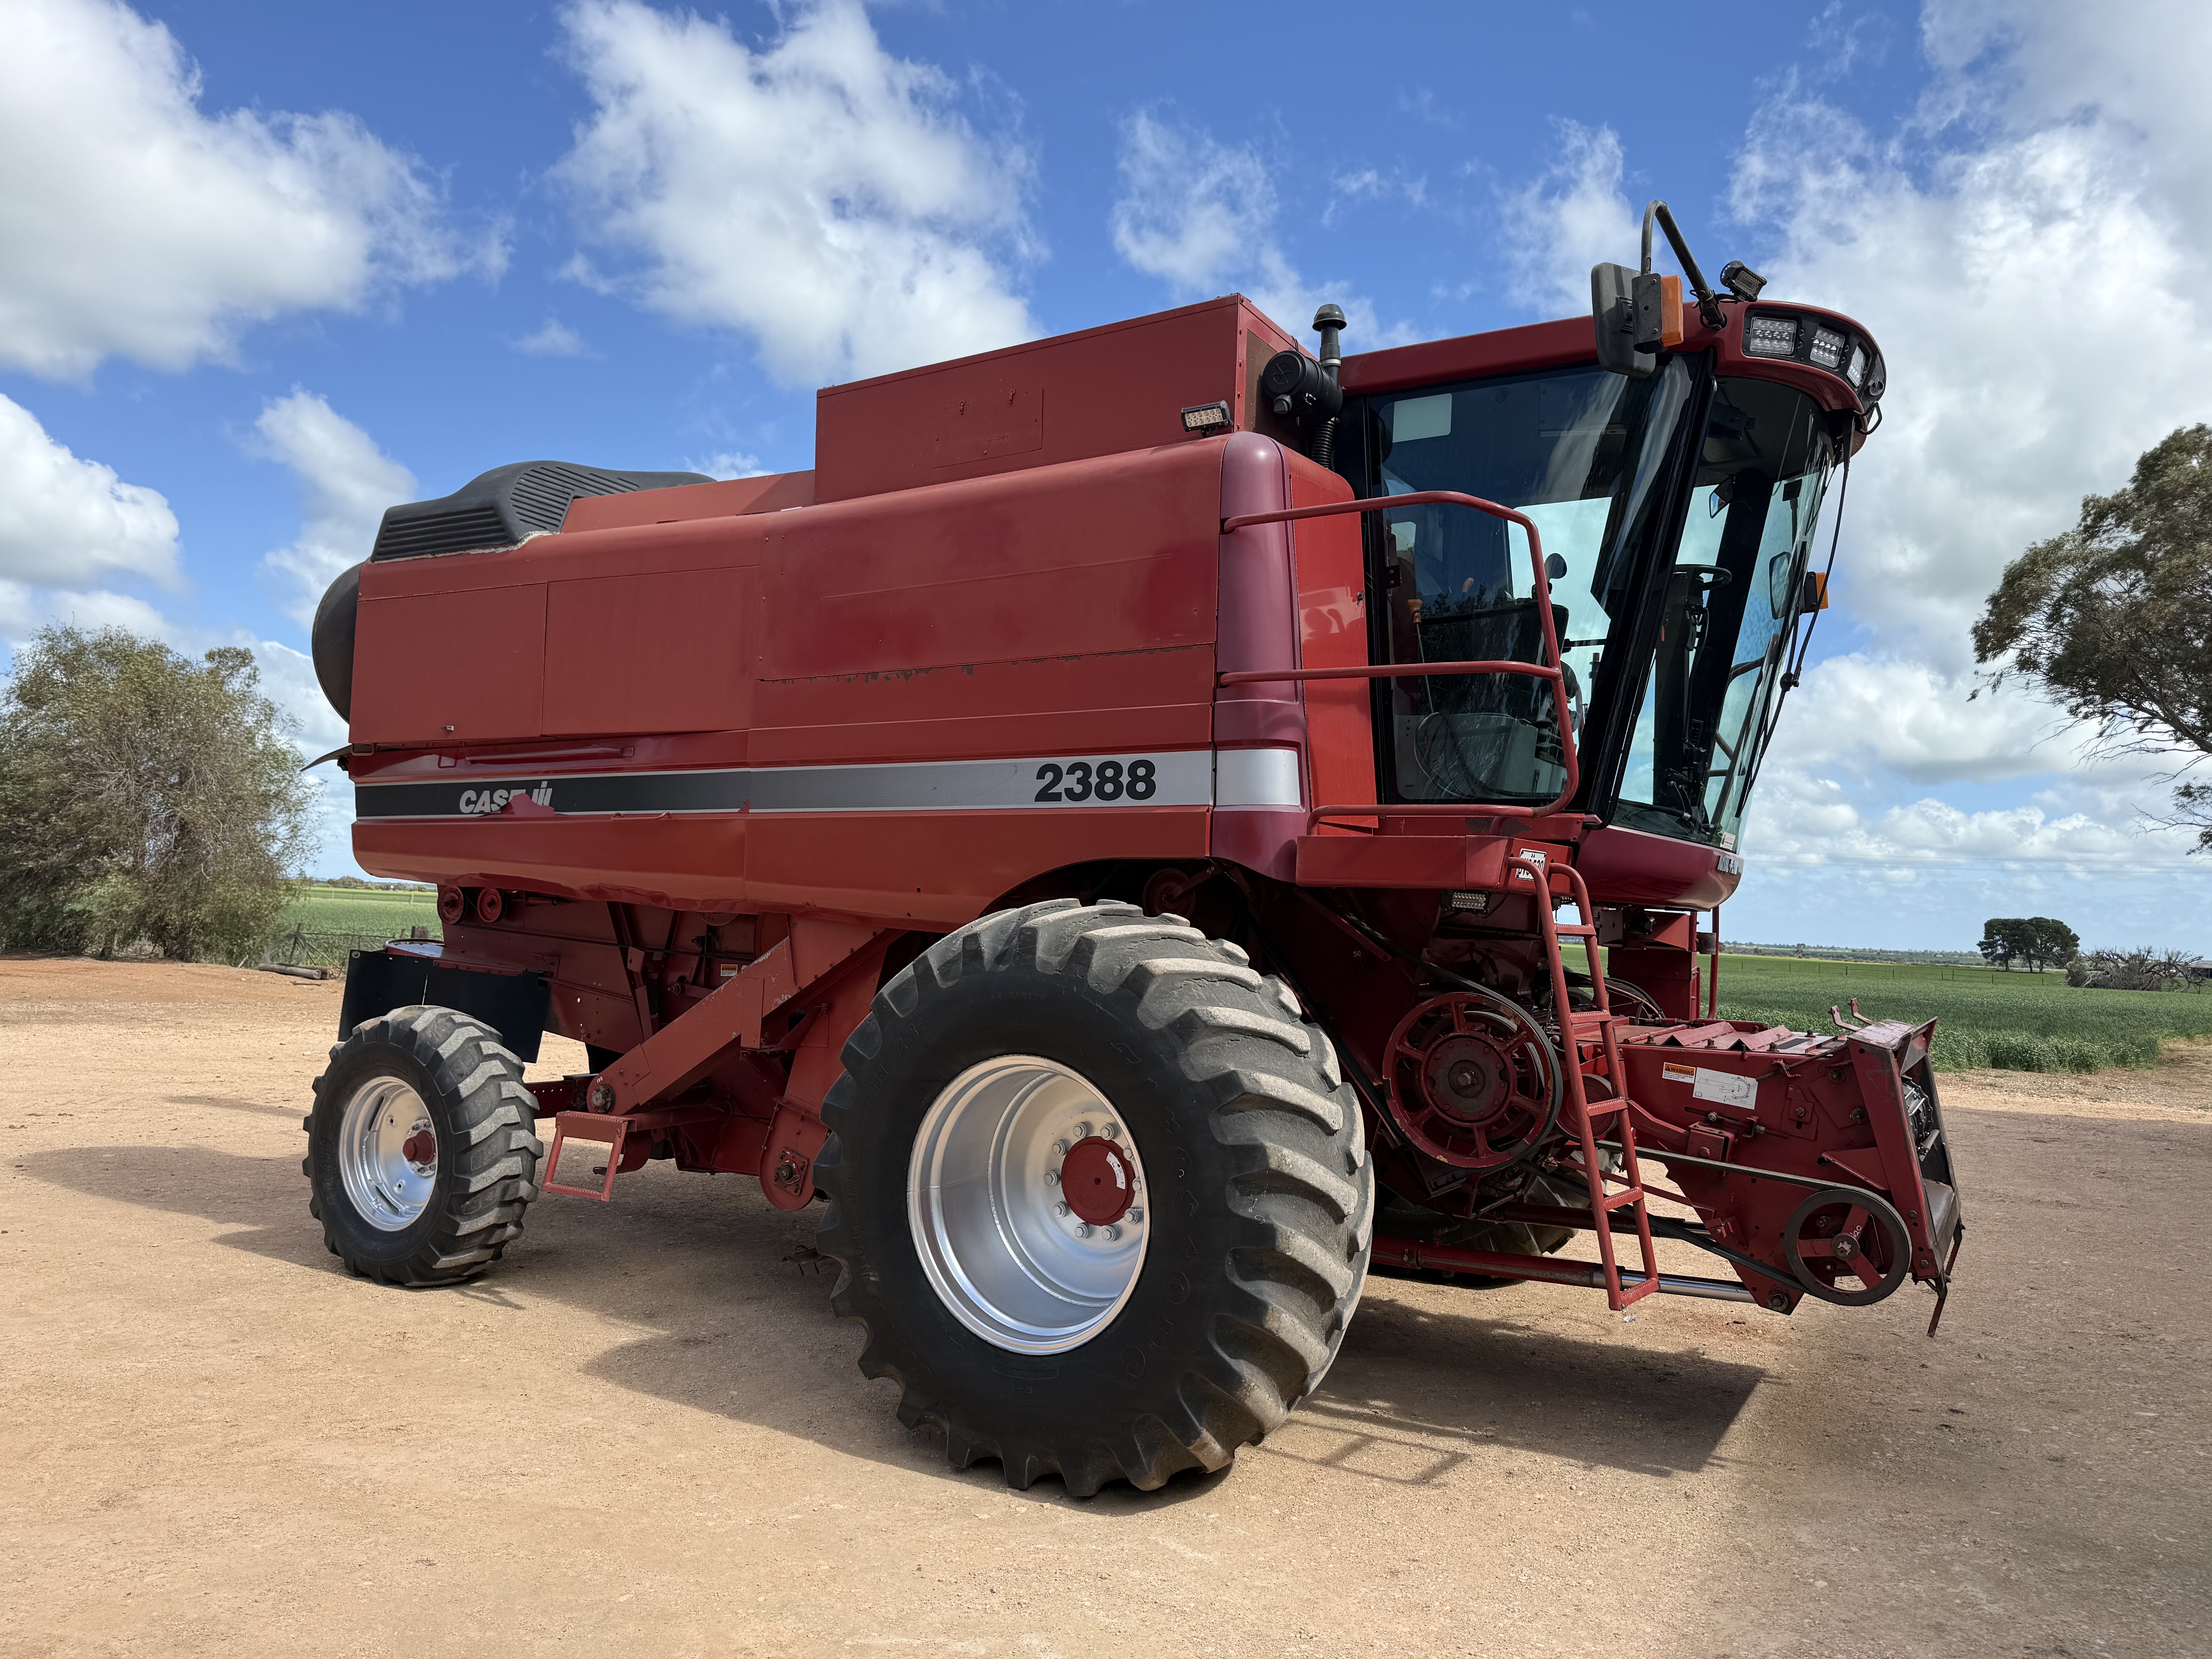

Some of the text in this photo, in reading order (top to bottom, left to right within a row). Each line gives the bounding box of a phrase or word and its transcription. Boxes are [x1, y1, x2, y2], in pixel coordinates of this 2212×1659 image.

[1035, 759, 1156, 802] 2388
[1671, 1067, 1694, 1075] WARNING
[319, 1135, 333, 1172] 459
